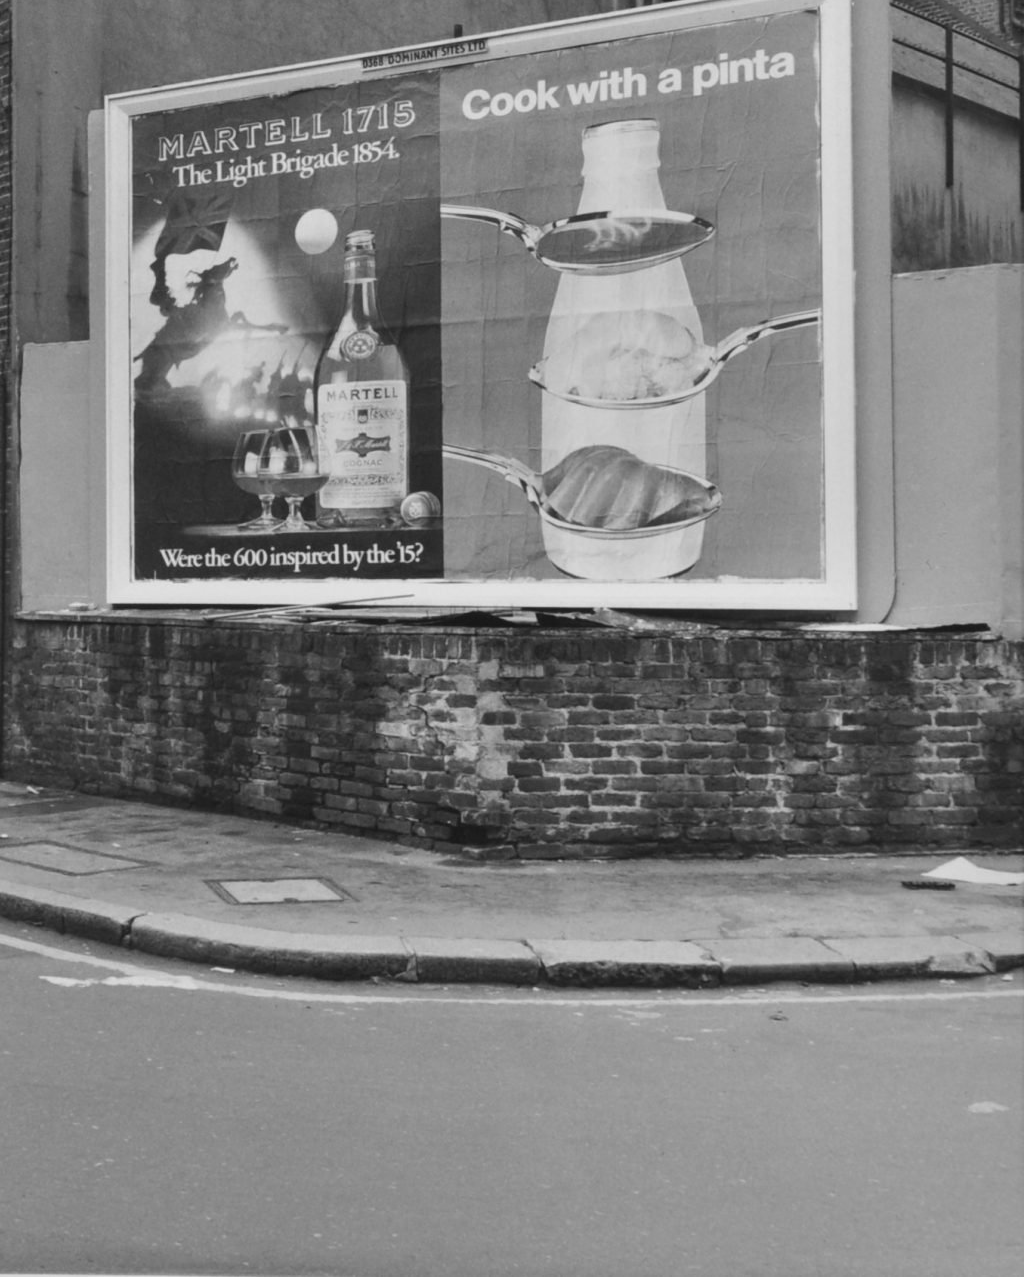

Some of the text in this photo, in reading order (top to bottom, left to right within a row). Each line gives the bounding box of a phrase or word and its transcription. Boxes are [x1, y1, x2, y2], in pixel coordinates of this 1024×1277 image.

[388, 48, 439, 65] DOMINANT
[441, 43, 465, 57] SITES
[468, 40, 486, 52] LTD
[462, 49, 796, 120] Cook with a pinta
[157, 99, 417, 161] MARTELL 1715
[172, 136, 401, 188] The Light Brigade 1854.
[327, 386, 398, 402] MARTELL
[343, 458, 383, 468] COGNAC
[159, 548, 203, 568] Were
[204, 547, 231, 567] the
[233, 547, 268, 567] 600
[269, 543, 341, 573] inspired
[342, 543, 366, 571] by
[366, 543, 396, 564] the
